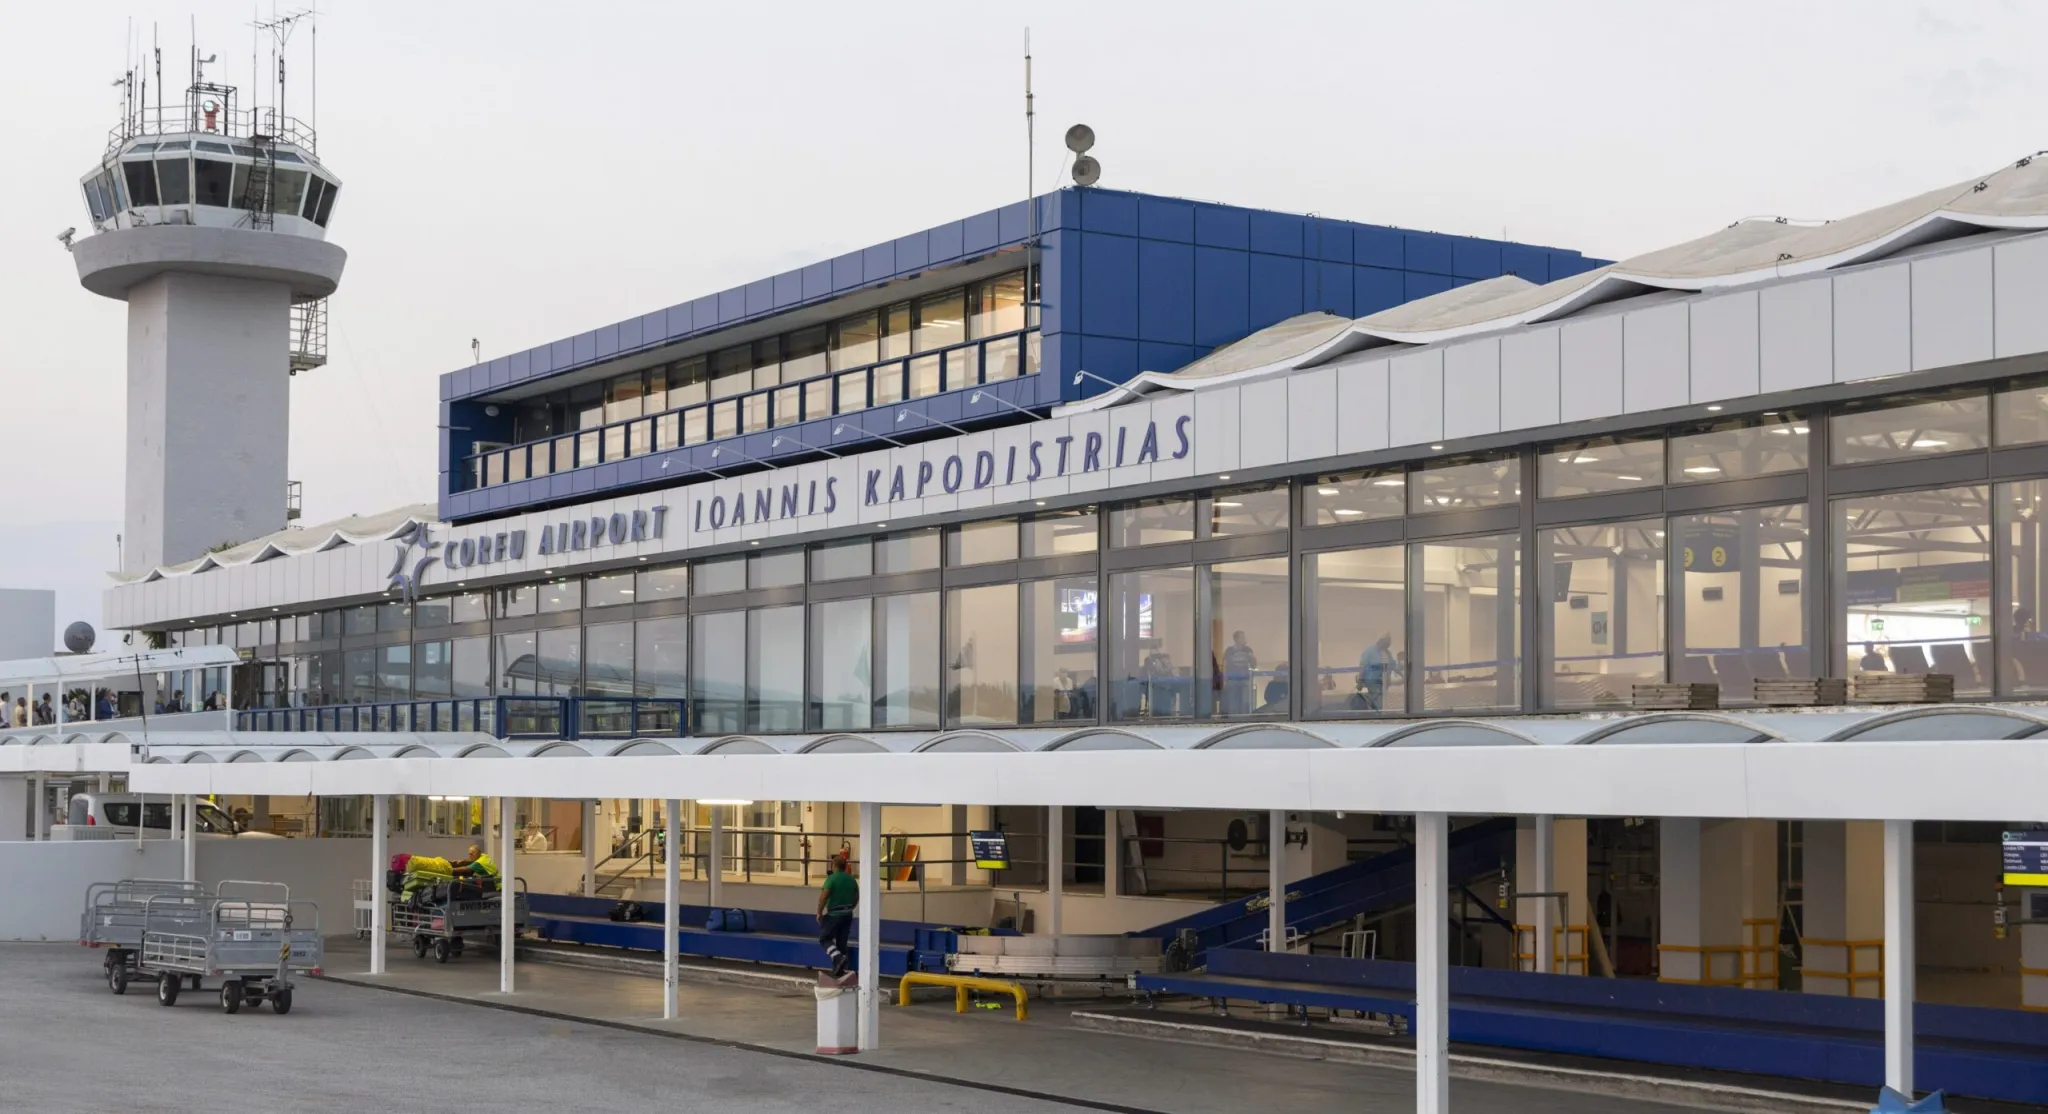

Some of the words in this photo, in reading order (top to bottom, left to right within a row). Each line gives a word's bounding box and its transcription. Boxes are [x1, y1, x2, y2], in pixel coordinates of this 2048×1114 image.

[444, 530, 526, 570] CORFU
[537, 505, 669, 556] AIRPORT
[694, 477, 838, 533] IOANNIS
[865, 415, 1191, 506] KAPODISTRIAS
